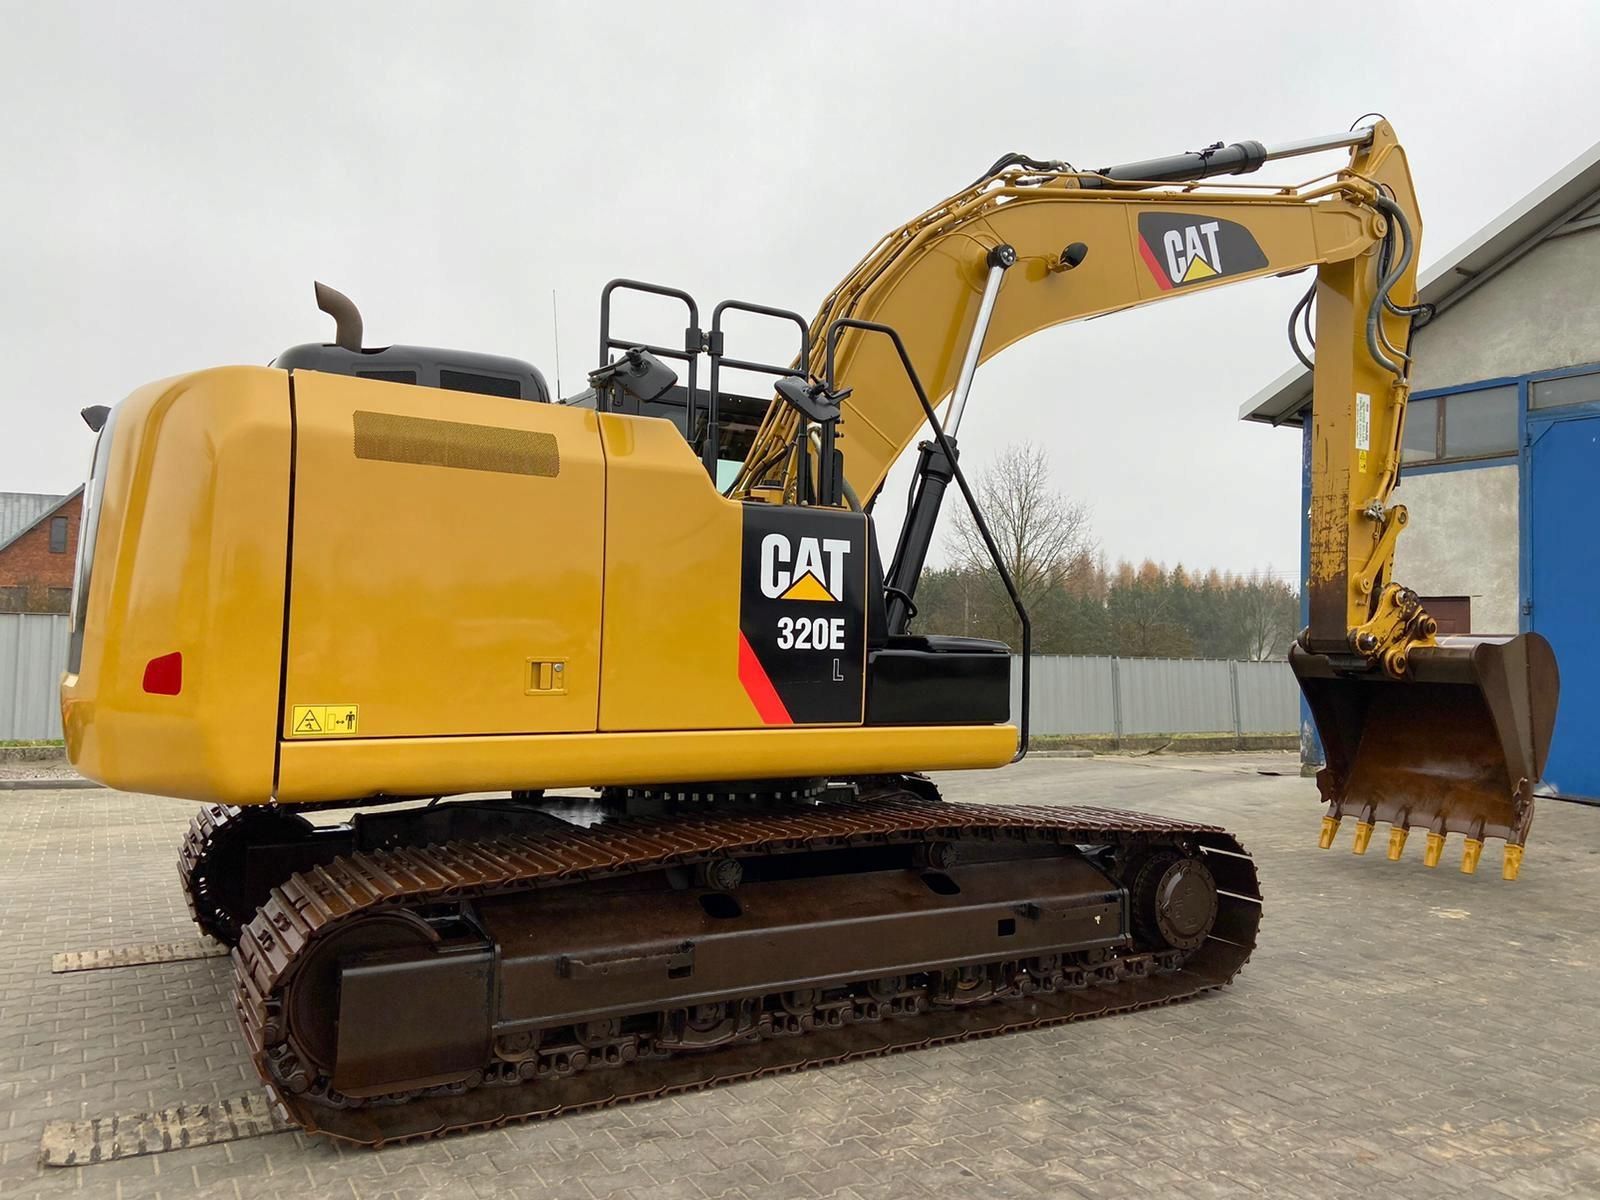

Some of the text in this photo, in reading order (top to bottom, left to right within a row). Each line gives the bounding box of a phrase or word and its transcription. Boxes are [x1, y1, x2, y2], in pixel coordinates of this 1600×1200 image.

[1163, 221, 1223, 284] CAT
[760, 533, 851, 602] CAT
[777, 616, 845, 650] 320E
[832, 657, 845, 682] L
